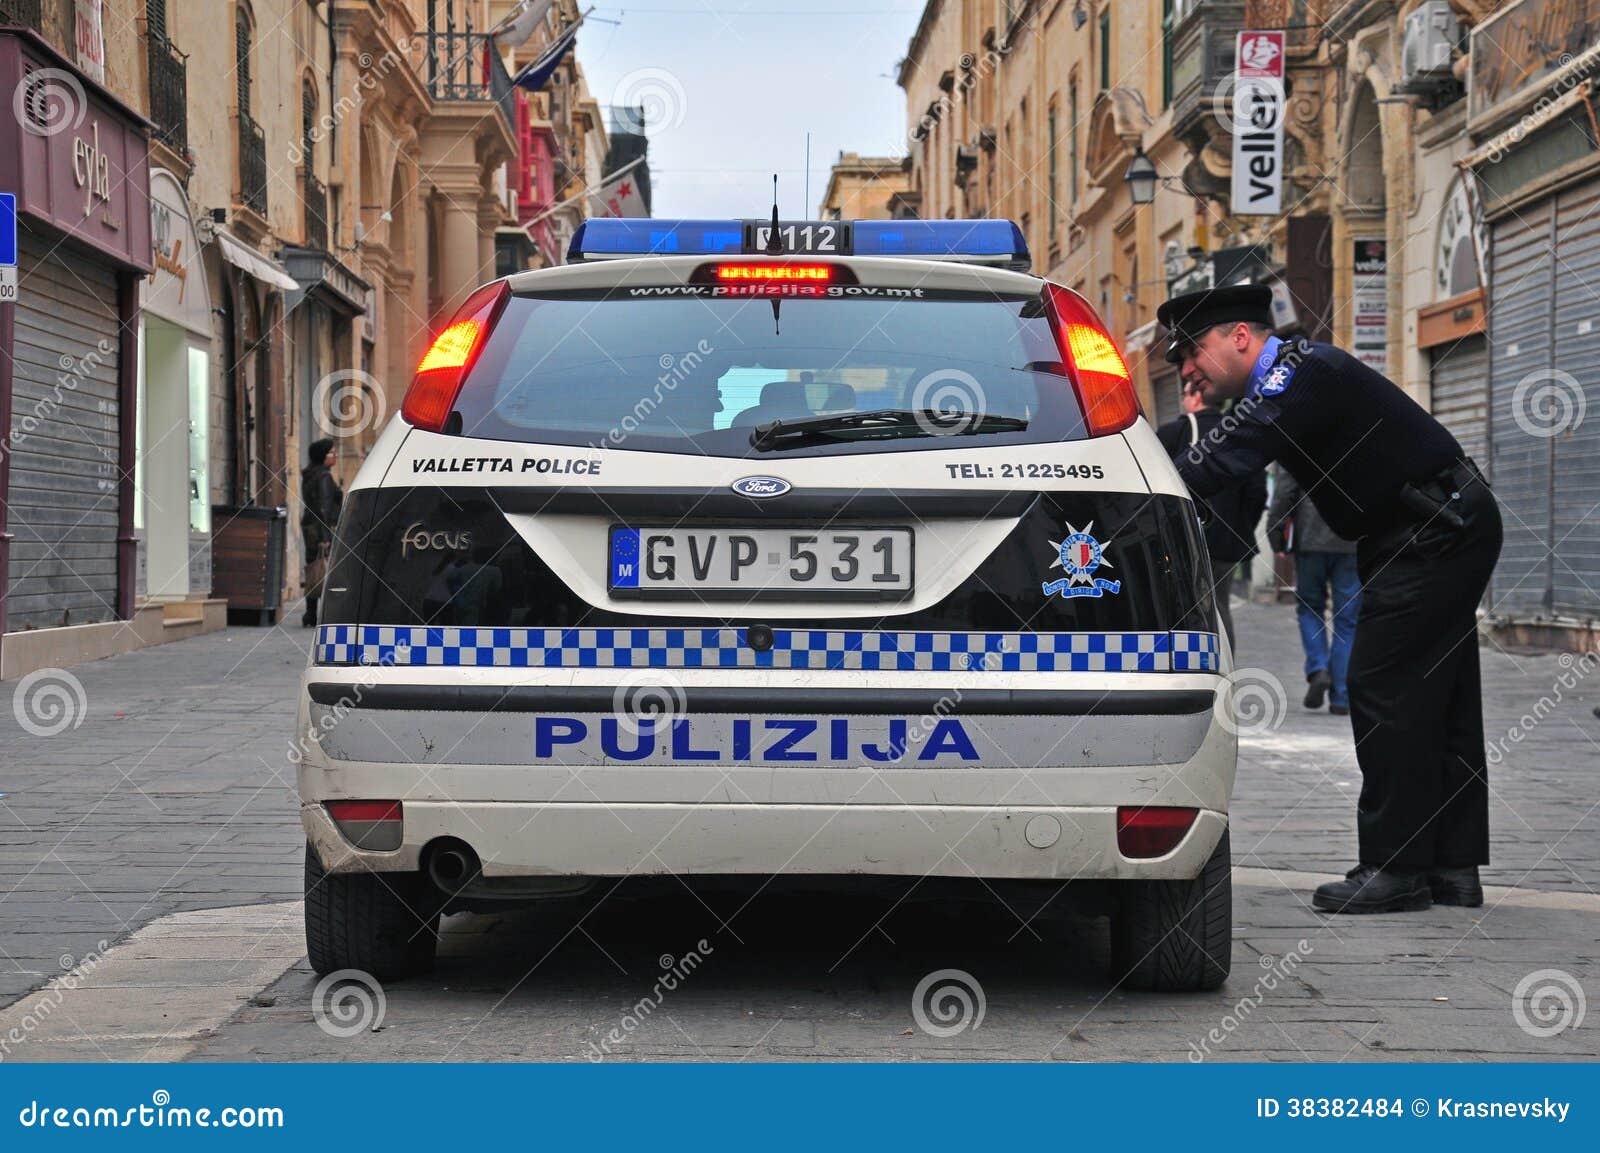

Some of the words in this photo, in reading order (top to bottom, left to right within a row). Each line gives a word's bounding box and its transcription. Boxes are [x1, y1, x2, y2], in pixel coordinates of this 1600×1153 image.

[1241, 87, 1277, 203] veller
[783, 225, 836, 251] 112
[629, 284, 924, 298] www.pulizija.gov.mt
[412, 458, 513, 473] VALLETTA
[520, 458, 602, 475] POLICE
[945, 463, 994, 479] TEL:
[1001, 463, 1105, 480] 21225495
[745, 480, 777, 493] Ford
[646, 535, 759, 581] GVP
[789, 536, 900, 582] 531
[619, 563, 632, 577] M
[535, 717, 981, 761] PULIZIJA
